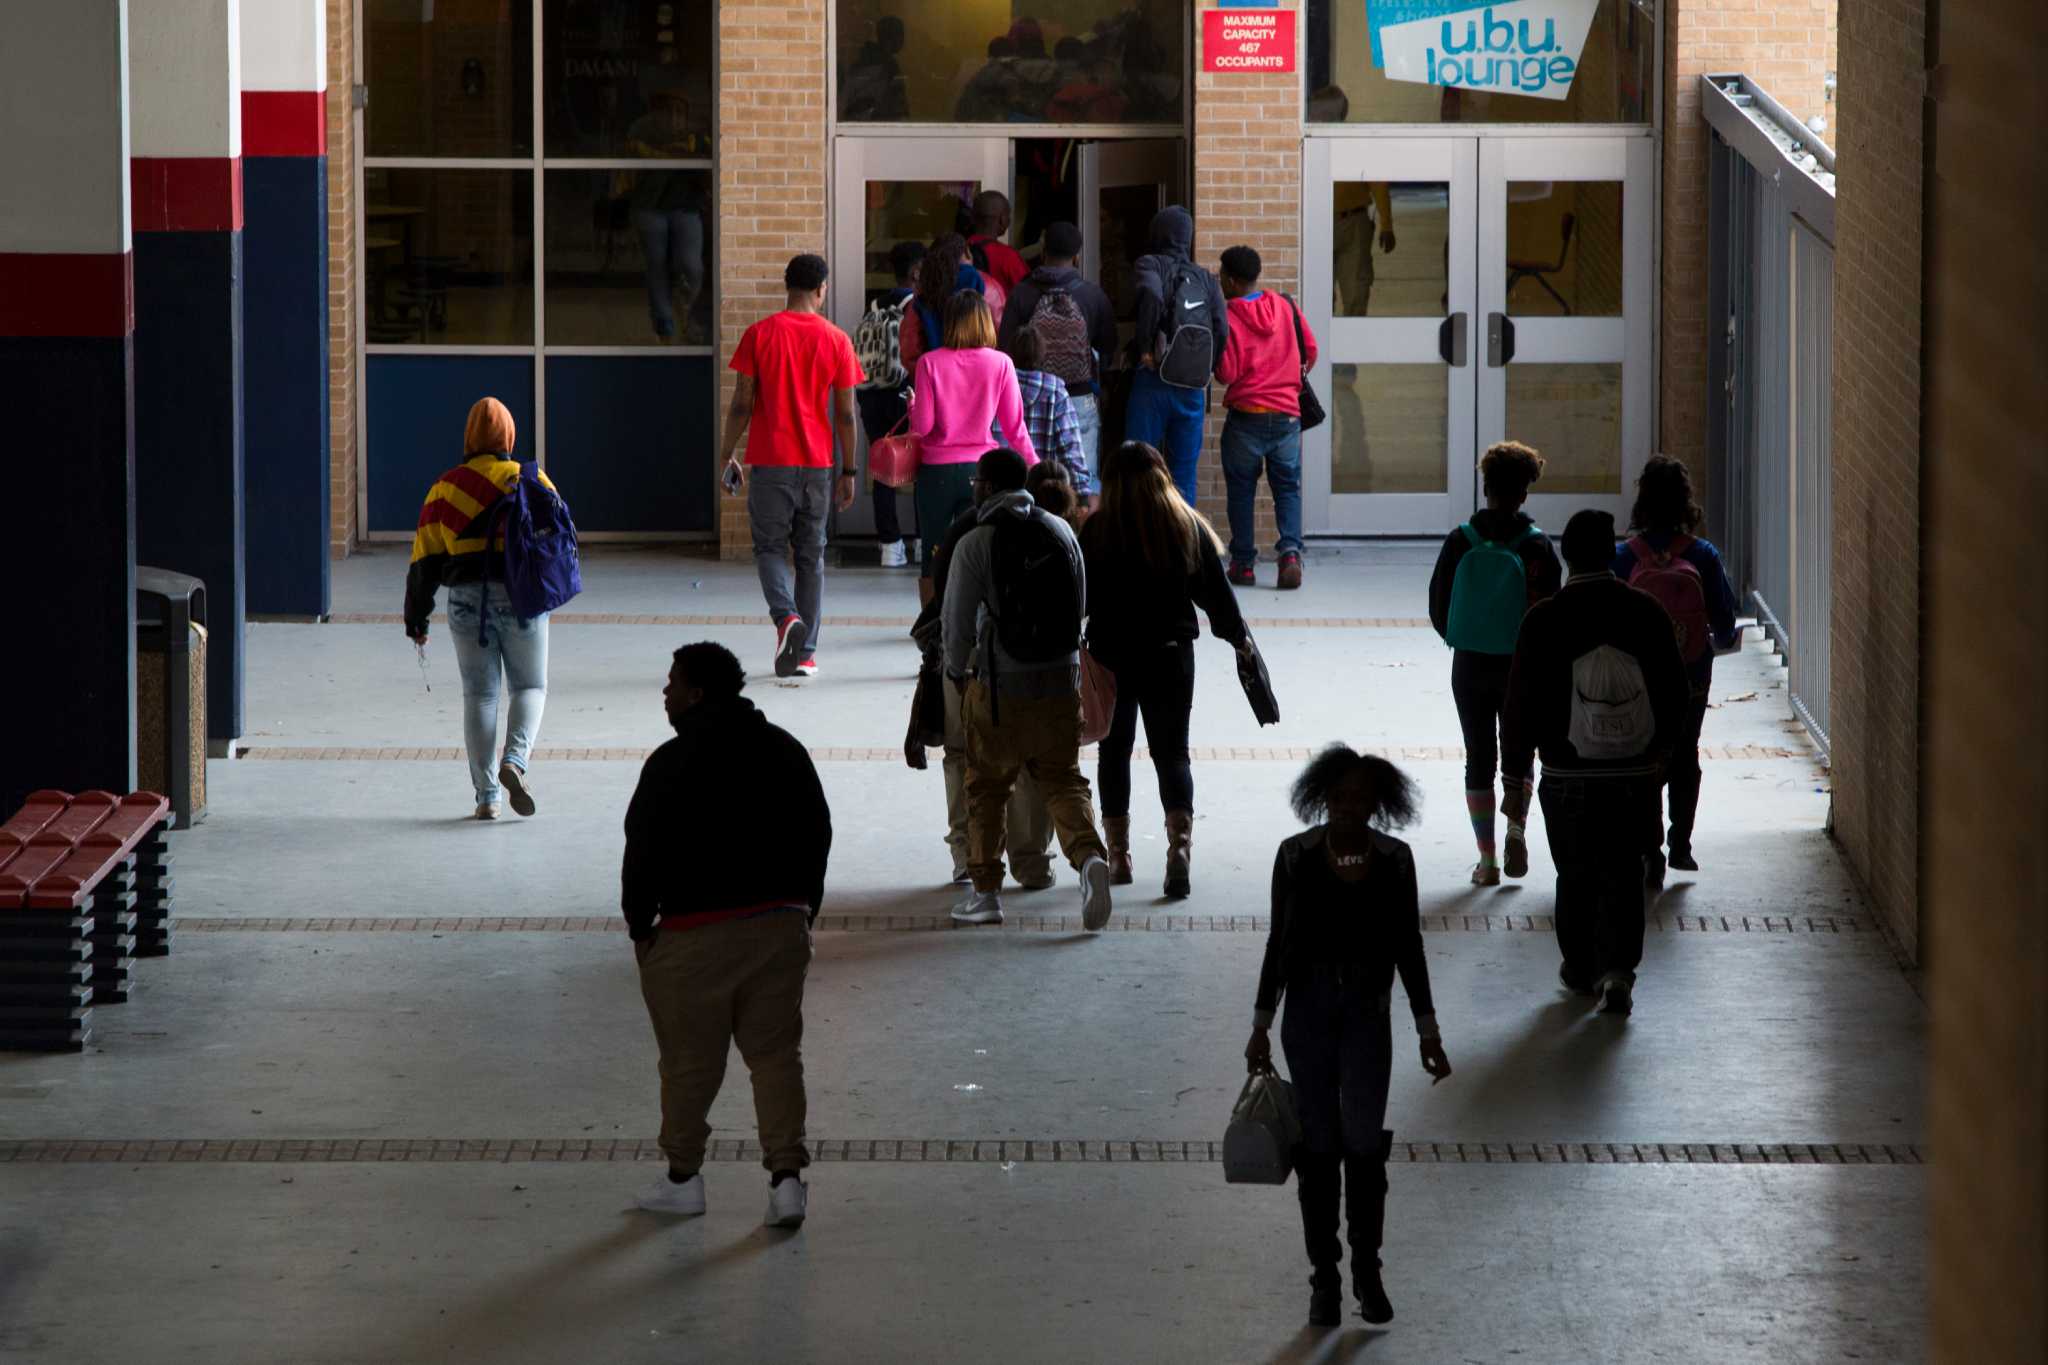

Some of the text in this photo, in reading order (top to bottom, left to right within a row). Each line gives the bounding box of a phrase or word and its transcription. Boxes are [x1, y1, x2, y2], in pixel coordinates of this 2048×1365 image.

[1223, 15, 1276, 26] MAXIMUM
[1222, 29, 1276, 40] CAPACITY
[1238, 42, 1261, 53] 467
[1215, 55, 1284, 67] OCCUPANTS
[1426, 48, 1575, 91] lounge
